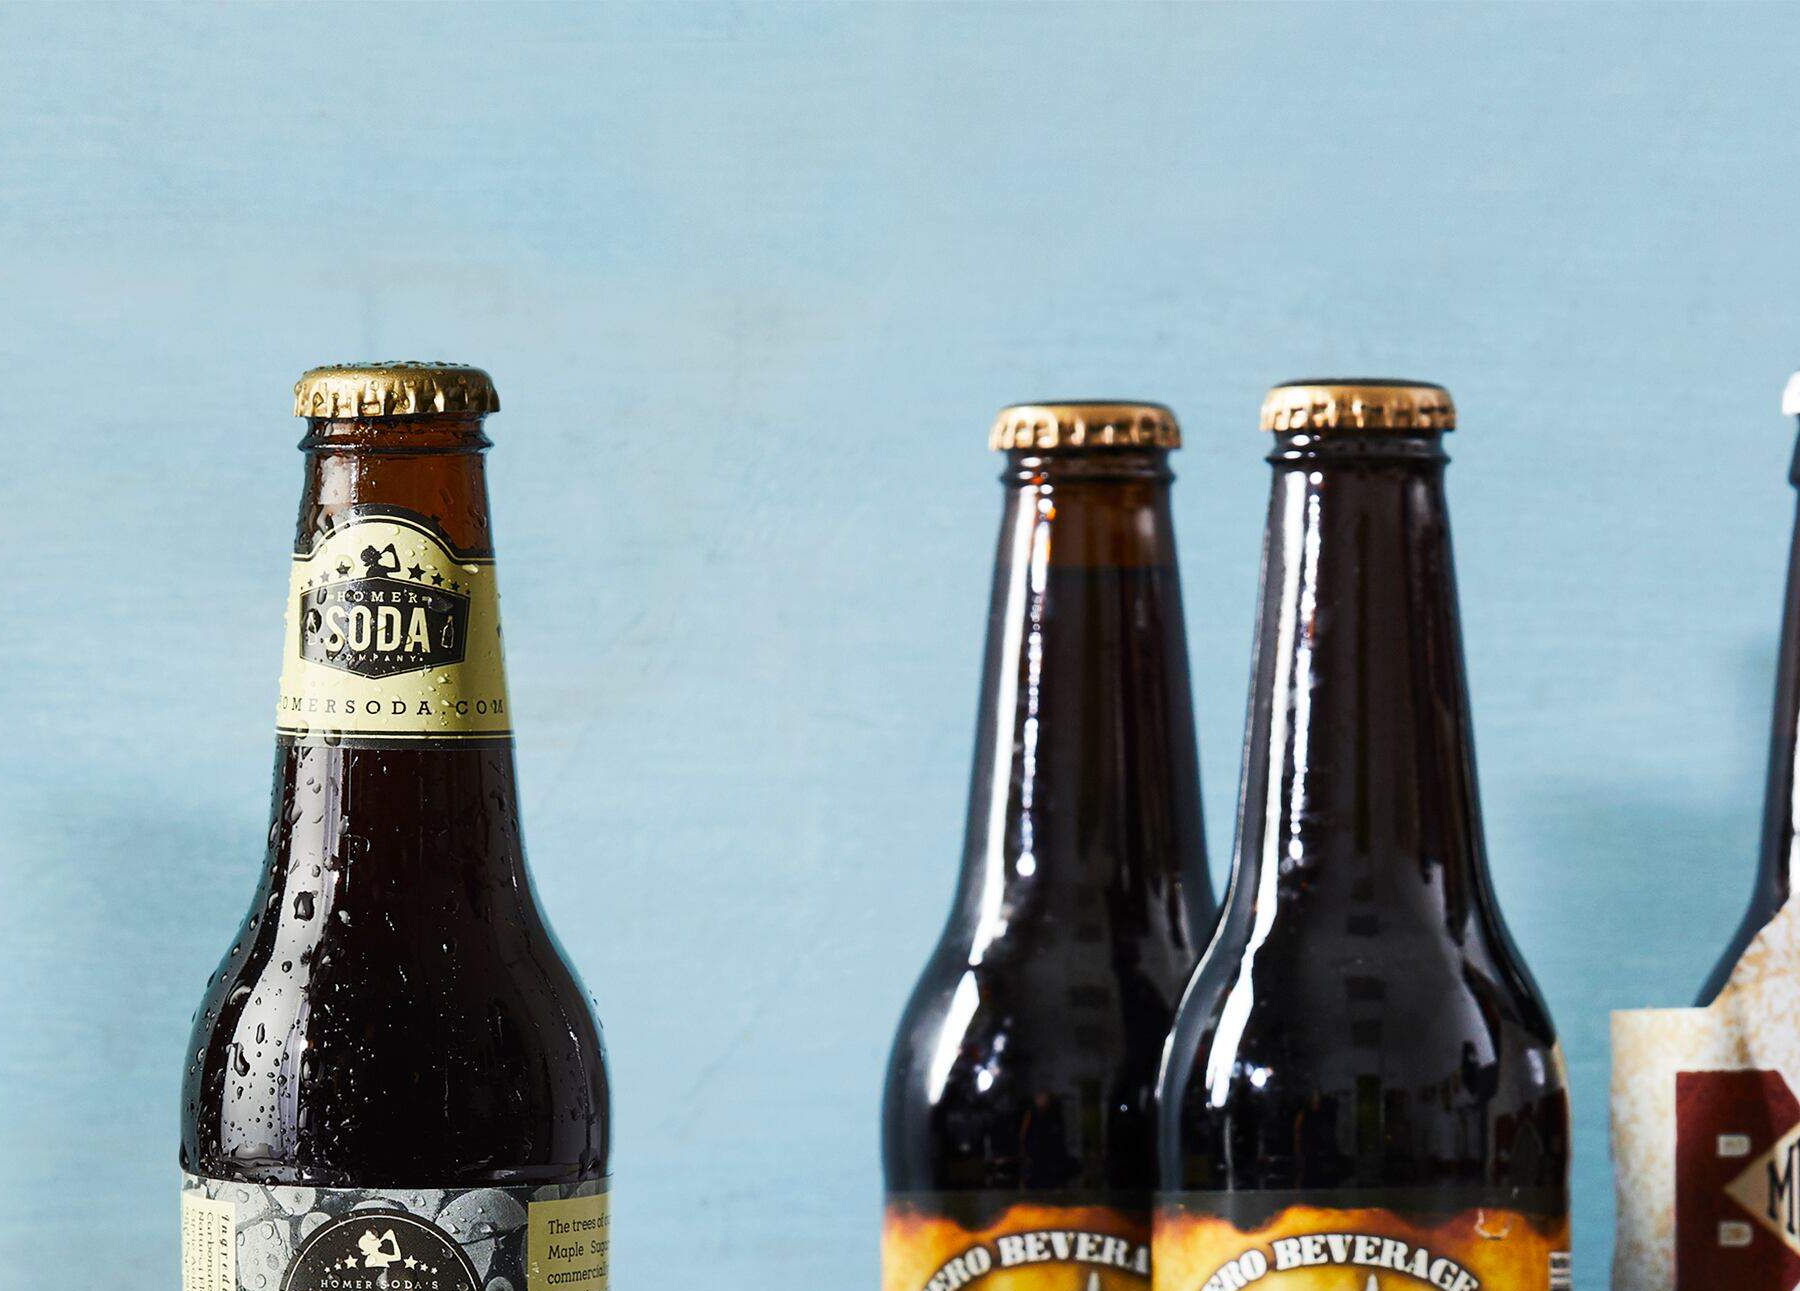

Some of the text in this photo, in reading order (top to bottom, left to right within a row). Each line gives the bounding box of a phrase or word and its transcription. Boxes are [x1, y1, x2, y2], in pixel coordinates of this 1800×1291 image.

[337, 591, 418, 604] HOMER
[325, 605, 431, 653] SODA
[548, 1216, 597, 1234] The trees
[548, 1243, 584, 1262] Maple
[321, 1280, 439, 1289] HOMER SODA'S
